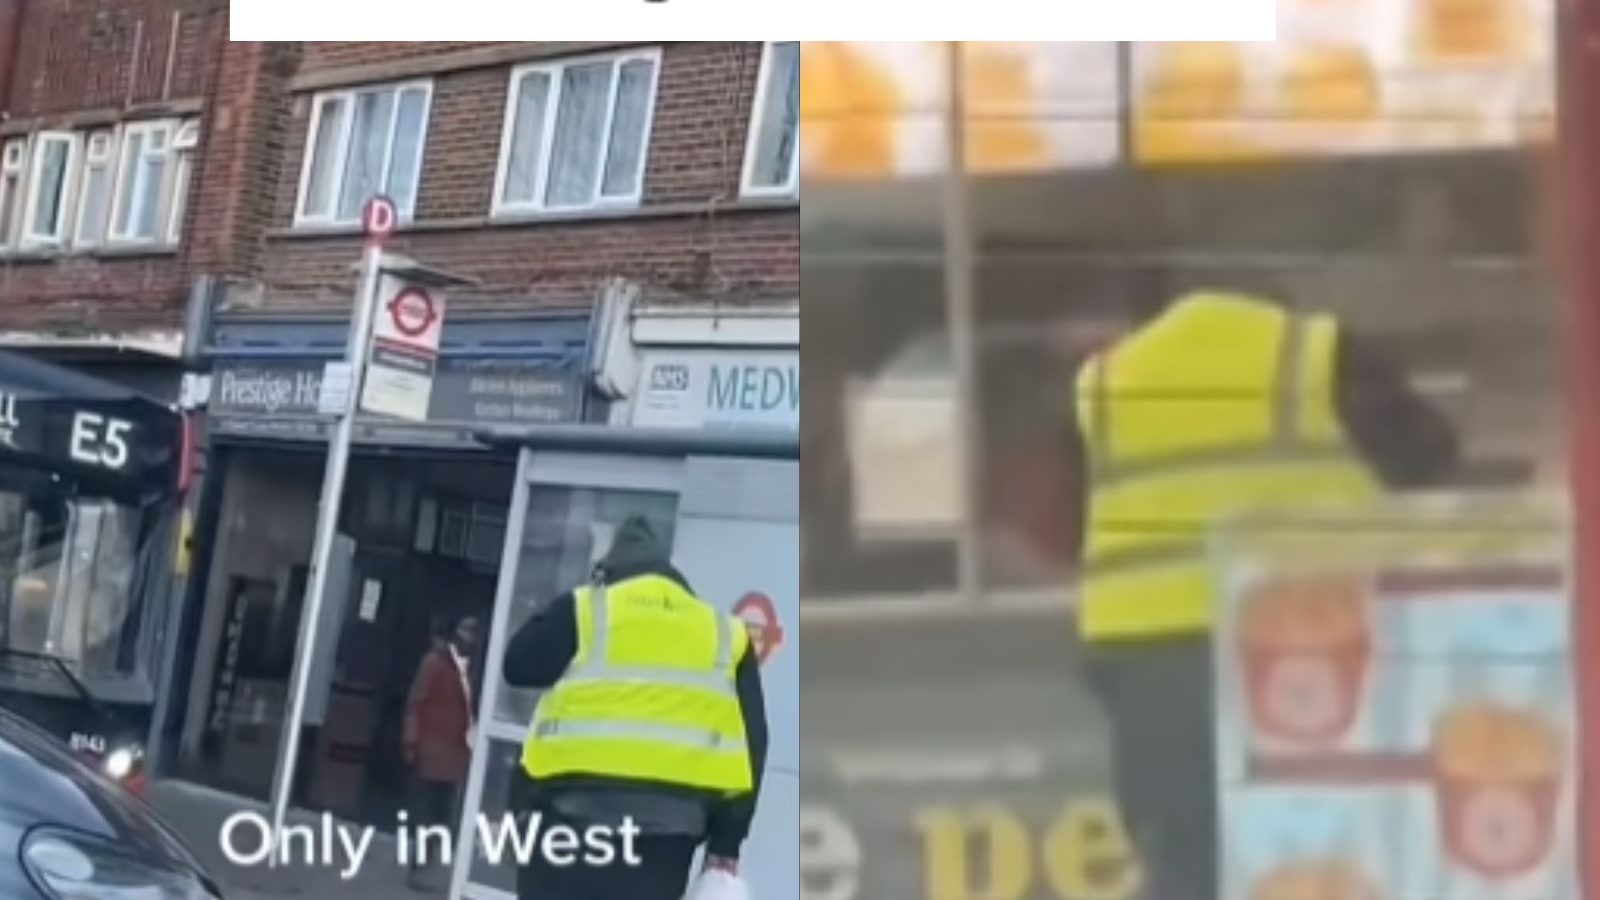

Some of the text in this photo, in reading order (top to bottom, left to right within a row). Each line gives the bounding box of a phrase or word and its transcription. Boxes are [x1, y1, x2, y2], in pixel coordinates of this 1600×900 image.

[370, 199, 393, 233] D
[221, 371, 292, 411] Prestige
[70, 411, 132, 469] E5
